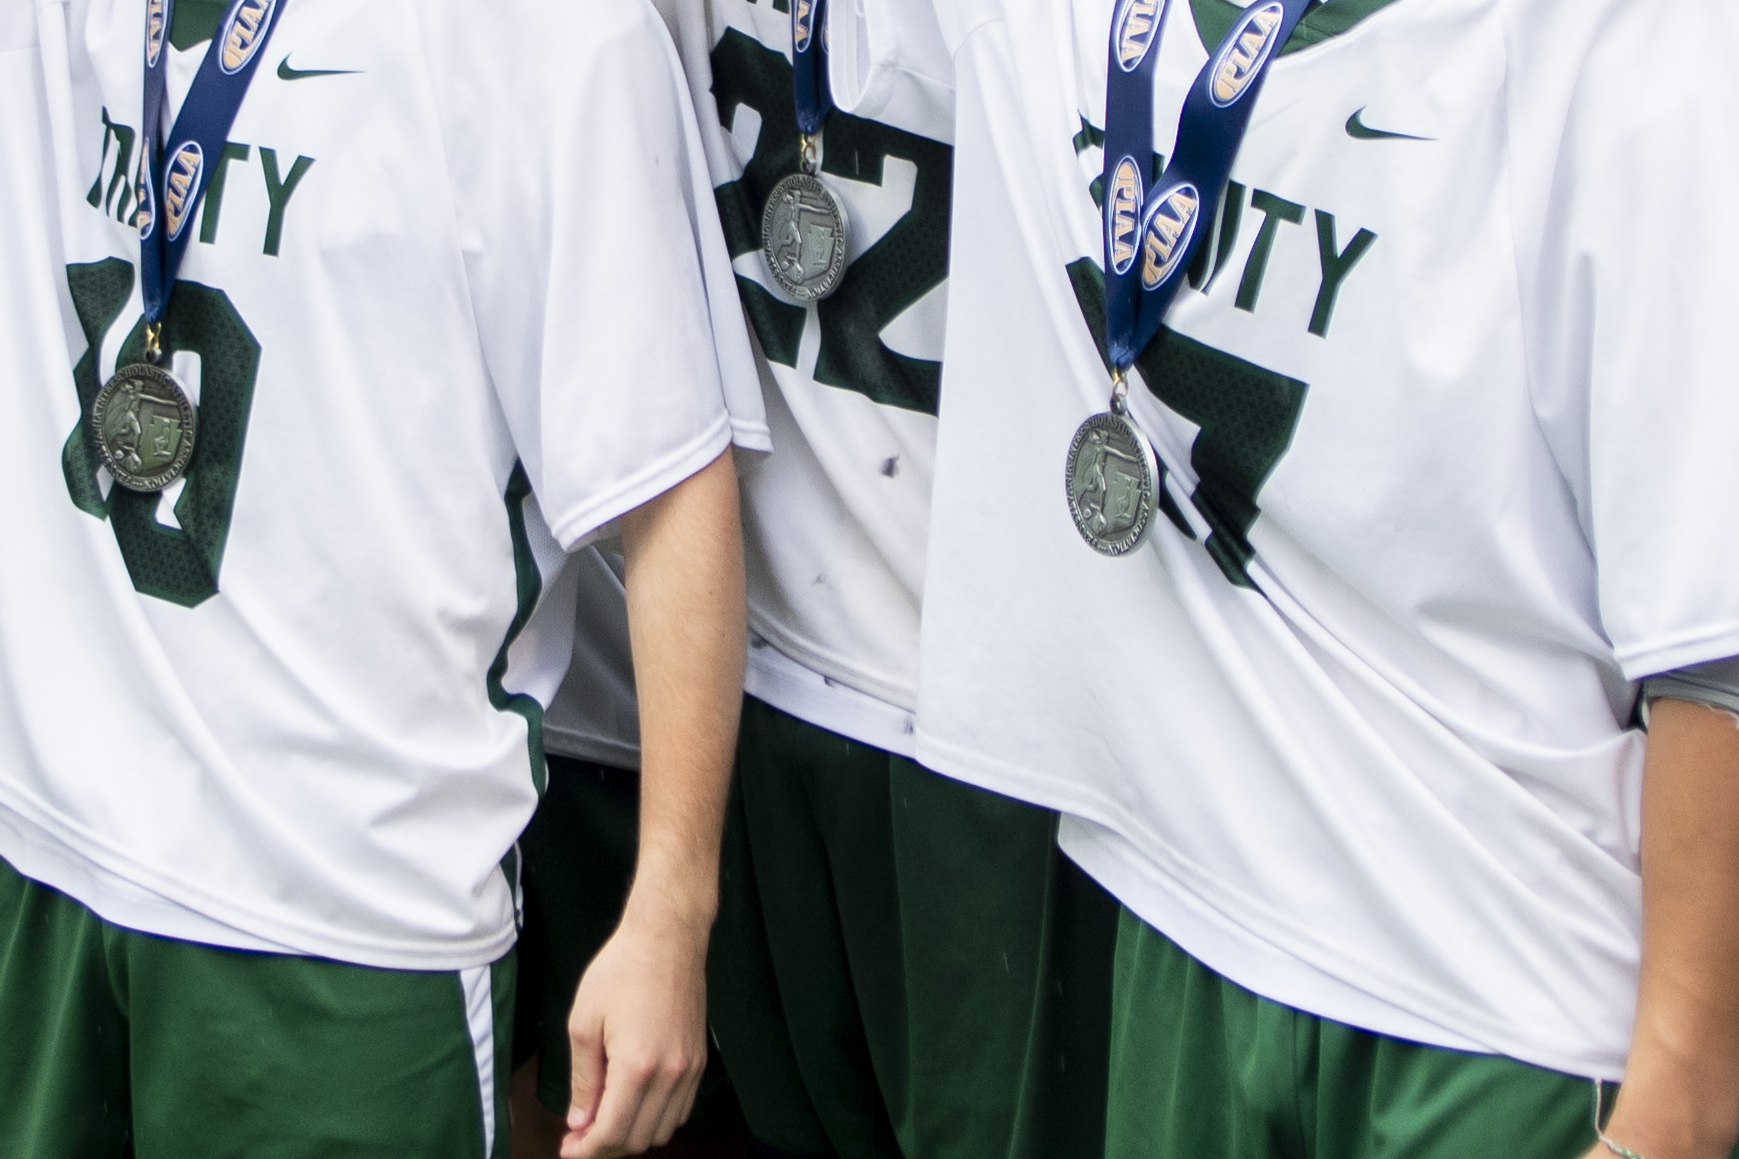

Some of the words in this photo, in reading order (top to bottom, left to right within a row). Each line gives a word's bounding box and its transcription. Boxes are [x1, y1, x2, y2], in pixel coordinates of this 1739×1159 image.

[1213, 9, 1275, 102] PIAA
[165, 149, 202, 237] PIAA
[1112, 160, 1139, 265] PIAA
[1143, 191, 1198, 288] PIAA
